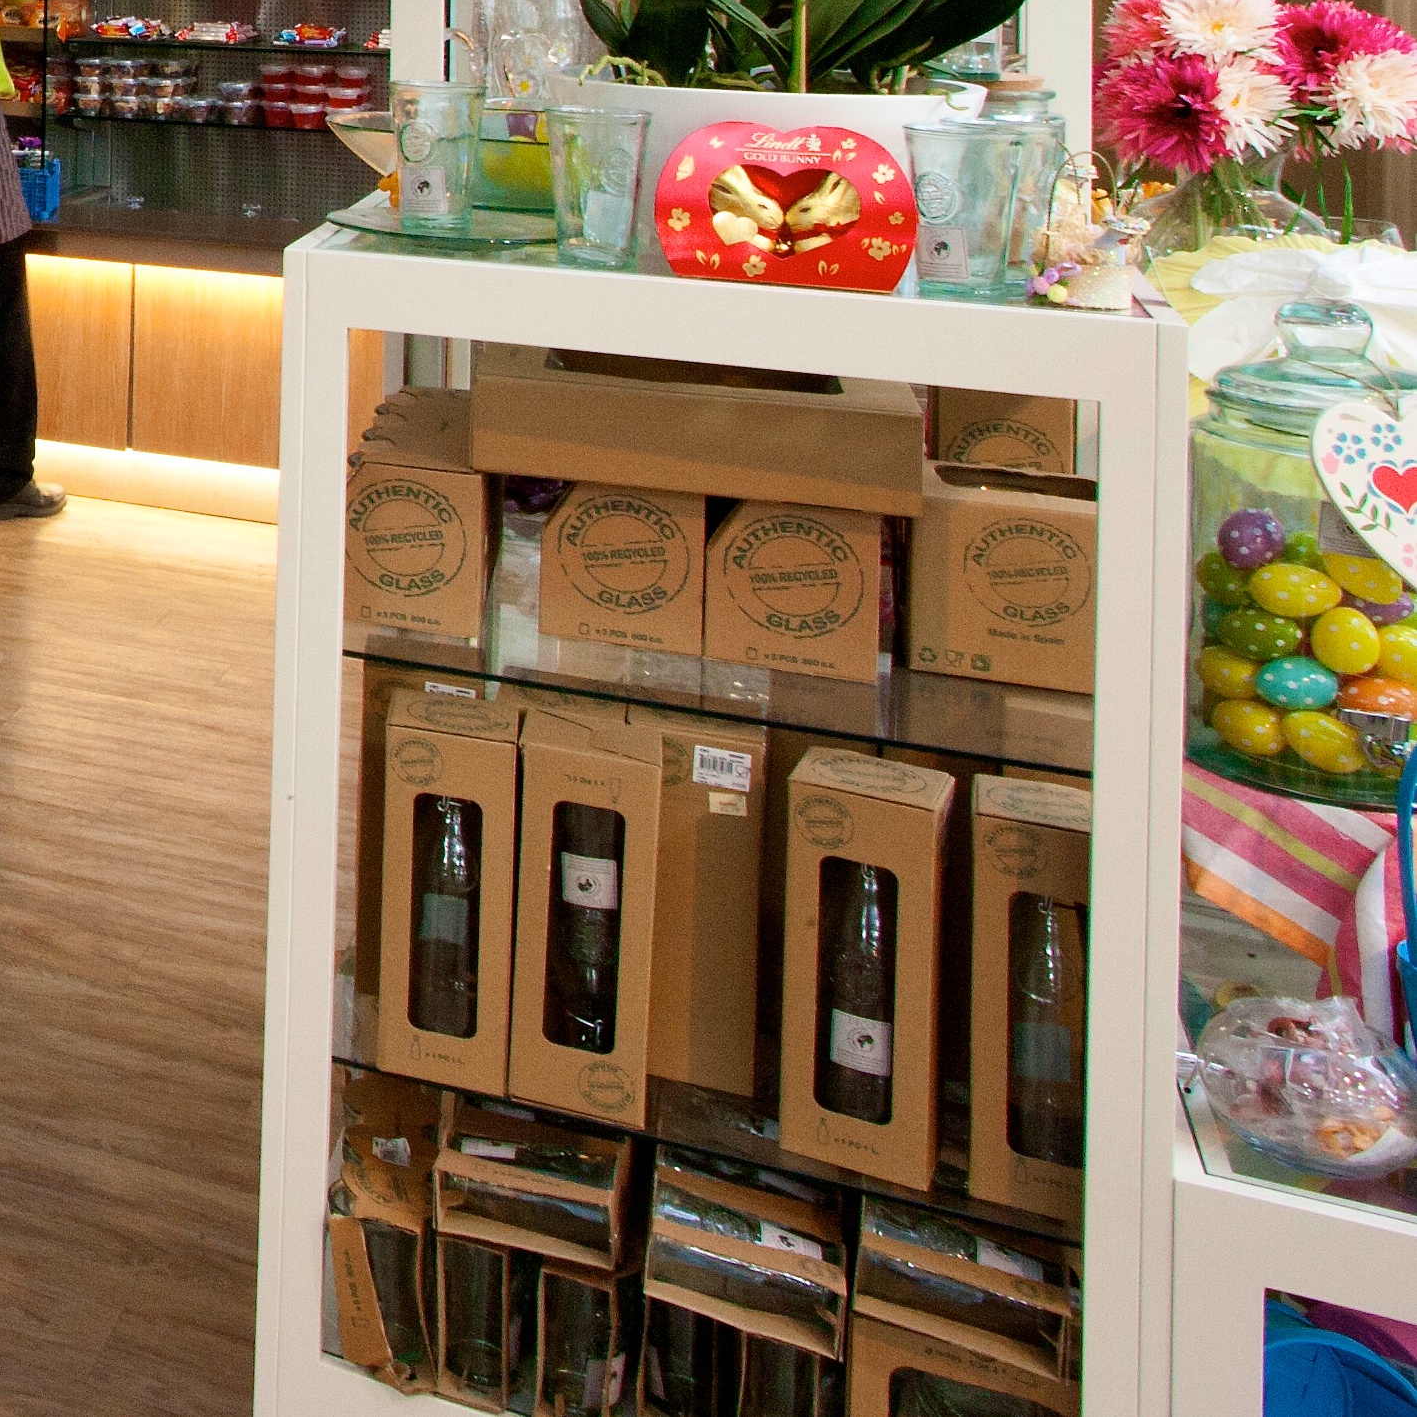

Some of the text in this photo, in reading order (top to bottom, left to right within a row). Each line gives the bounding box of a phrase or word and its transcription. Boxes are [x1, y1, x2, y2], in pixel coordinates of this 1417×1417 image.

[745, 132, 806, 151] Lindt
[743, 152, 822, 165] GOLD BUNNY
[349, 485, 453, 532] AUTHENTIC
[566, 500, 675, 547] AUTHENTIC
[610, 546, 666, 560] RECYCLED
[732, 521, 849, 569] AUTHENTIC
[973, 524, 1077, 567] AUTHENTIC
[378, 569, 446, 592] GLASS
[779, 568, 838, 582] RECYCLED
[598, 586, 667, 608] GLASS
[766, 609, 841, 633] GLASS
[1002, 601, 1070, 622] GLASS
